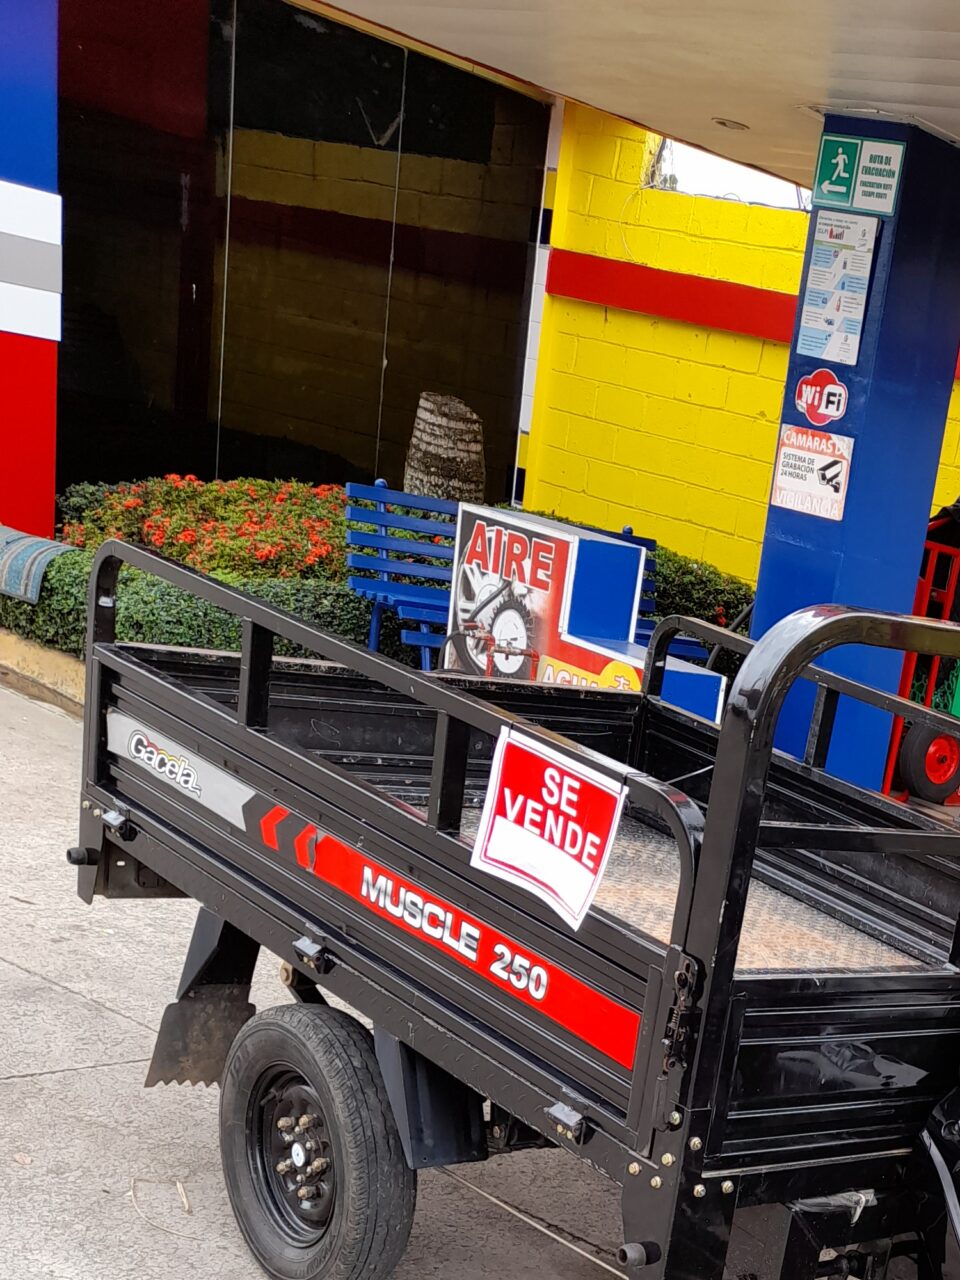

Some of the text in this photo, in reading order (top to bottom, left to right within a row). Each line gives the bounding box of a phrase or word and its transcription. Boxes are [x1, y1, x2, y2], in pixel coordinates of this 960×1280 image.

[869, 154, 892, 166] RUTA DE
[780, 469, 808, 481] 24 HORAS
[783, 452, 816, 466] SISTEMA DE
[777, 490, 839, 517] VIGILANCIA
[465, 520, 557, 594] AIRE
[542, 663, 599, 688] AGU
[128, 729, 202, 797] Gacela
[541, 767, 581, 817] SE
[503, 787, 601, 869] VENDE
[361, 865, 549, 1001] MUSCLE 250
